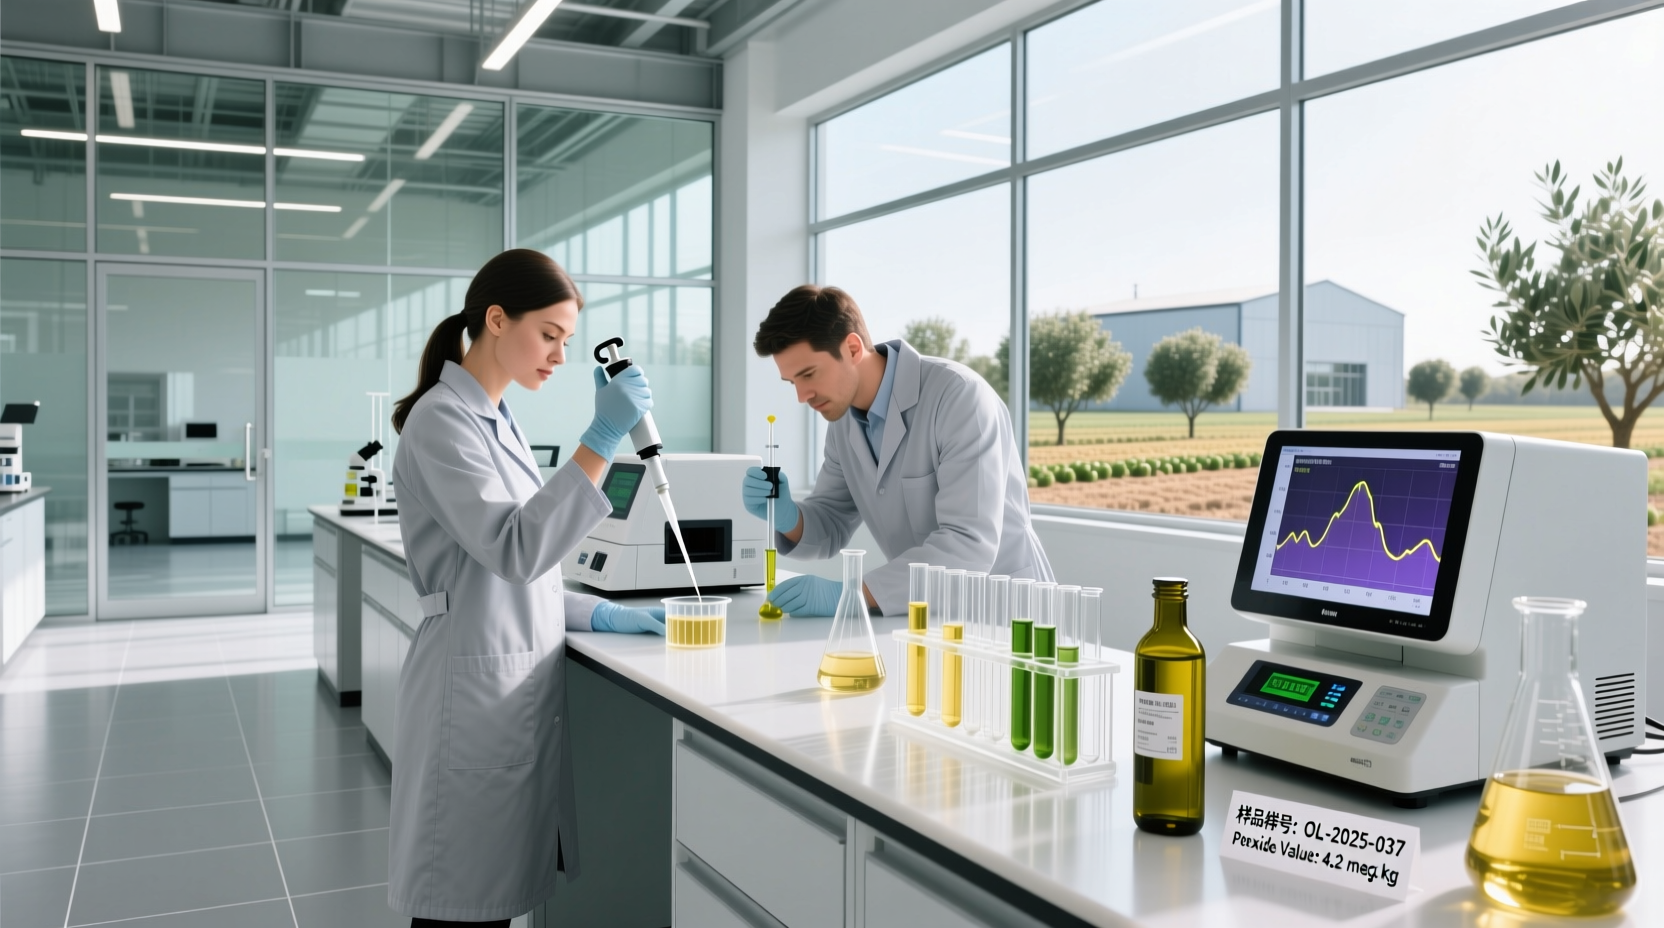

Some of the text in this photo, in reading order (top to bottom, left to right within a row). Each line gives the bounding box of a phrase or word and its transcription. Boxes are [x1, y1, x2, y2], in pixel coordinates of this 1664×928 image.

[1304, 821, 1406, 857] OL-2025-037
[1280, 840, 1320, 864] Value:
[1321, 851, 1344, 870] 4.2
[1380, 863, 1400, 887] kg
